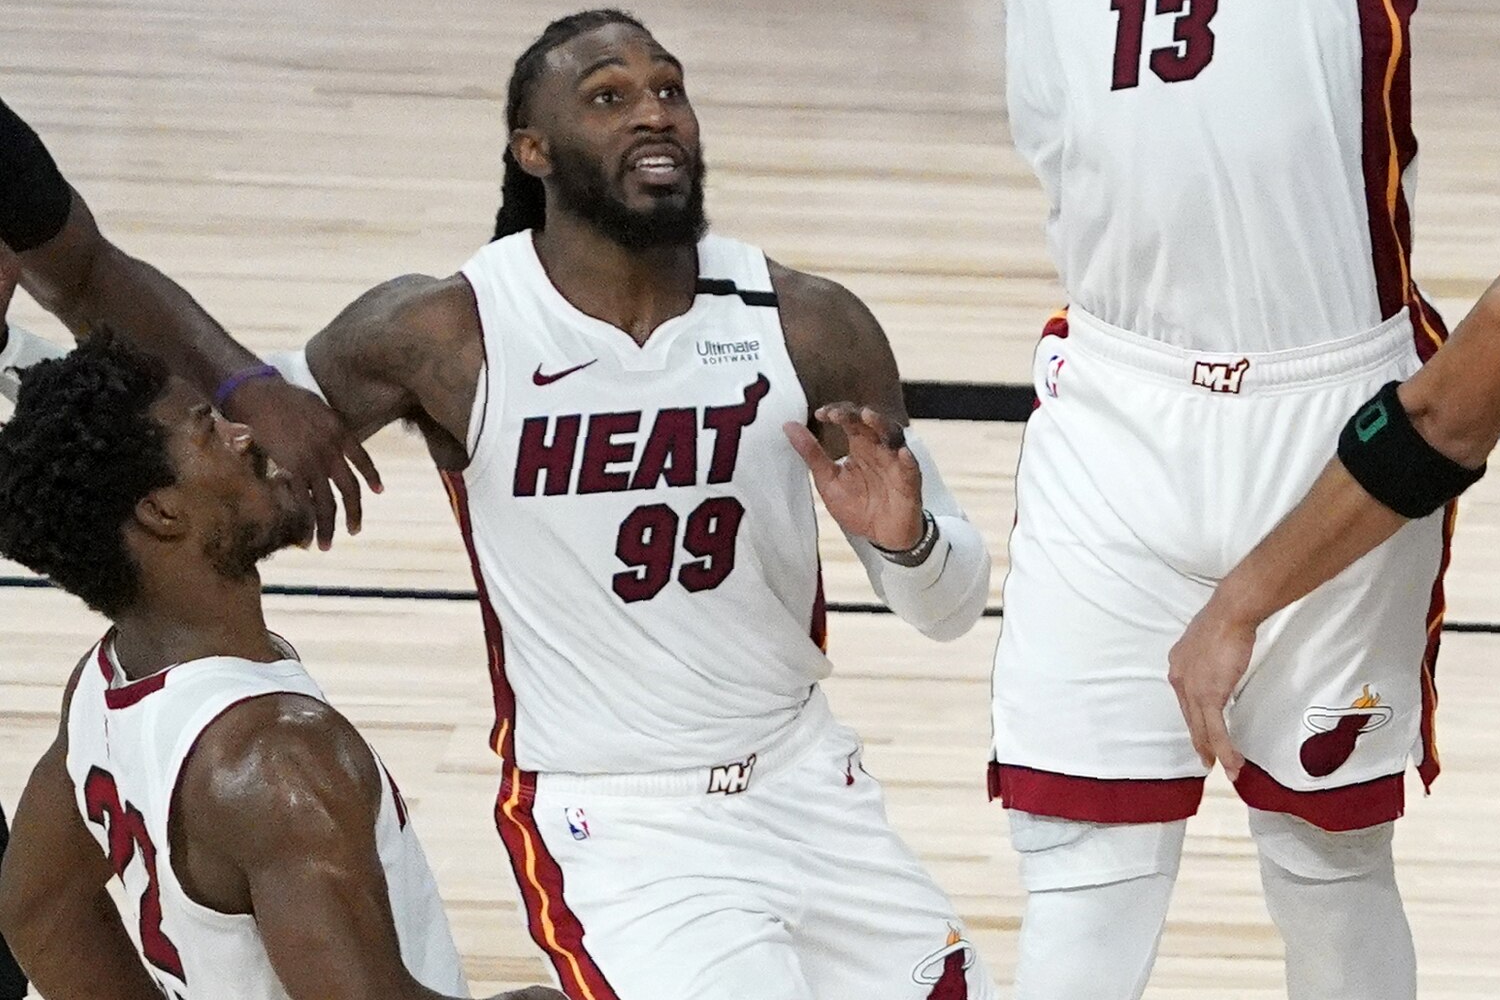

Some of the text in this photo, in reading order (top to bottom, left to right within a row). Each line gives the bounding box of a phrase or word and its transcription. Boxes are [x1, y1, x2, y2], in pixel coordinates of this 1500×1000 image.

[696, 340, 760, 356] Ultimate
[512, 372, 771, 498] HEAT
[612, 496, 746, 604] 99
